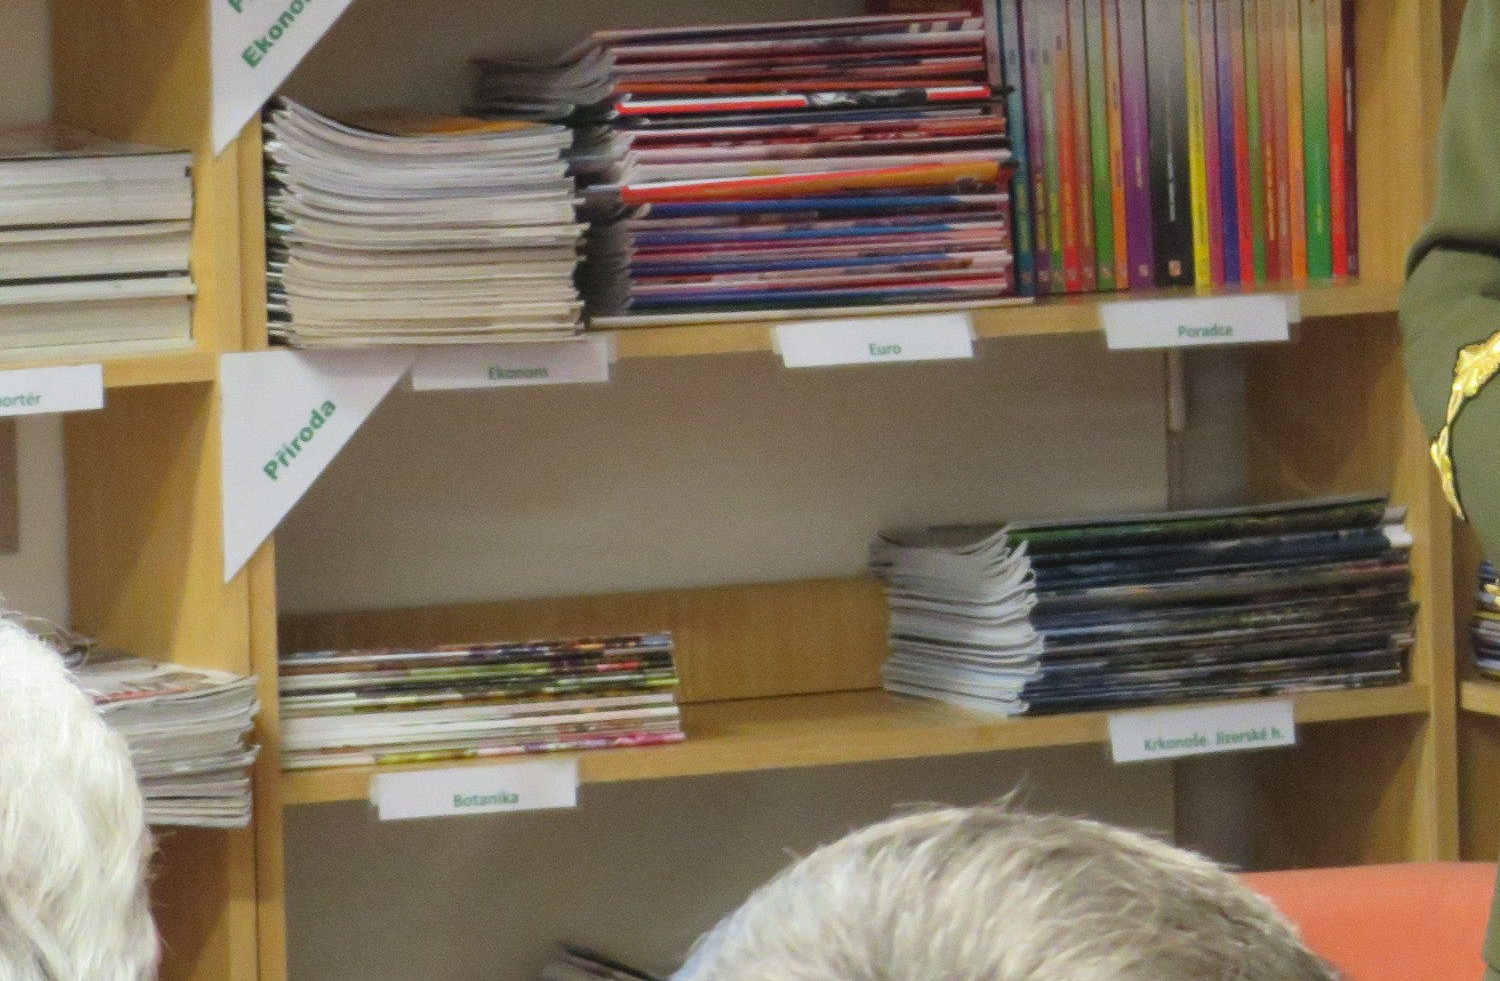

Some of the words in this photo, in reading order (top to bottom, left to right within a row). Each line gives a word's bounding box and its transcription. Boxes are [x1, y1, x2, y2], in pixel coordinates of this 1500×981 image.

[1177, 323, 1234, 338] Poradce
[869, 342, 902, 356] Euro
[488, 366, 549, 381] Ekonom
[0, 392, 41, 407] ortér
[262, 400, 336, 481] Příroda
[454, 791, 519, 808] Botanika
